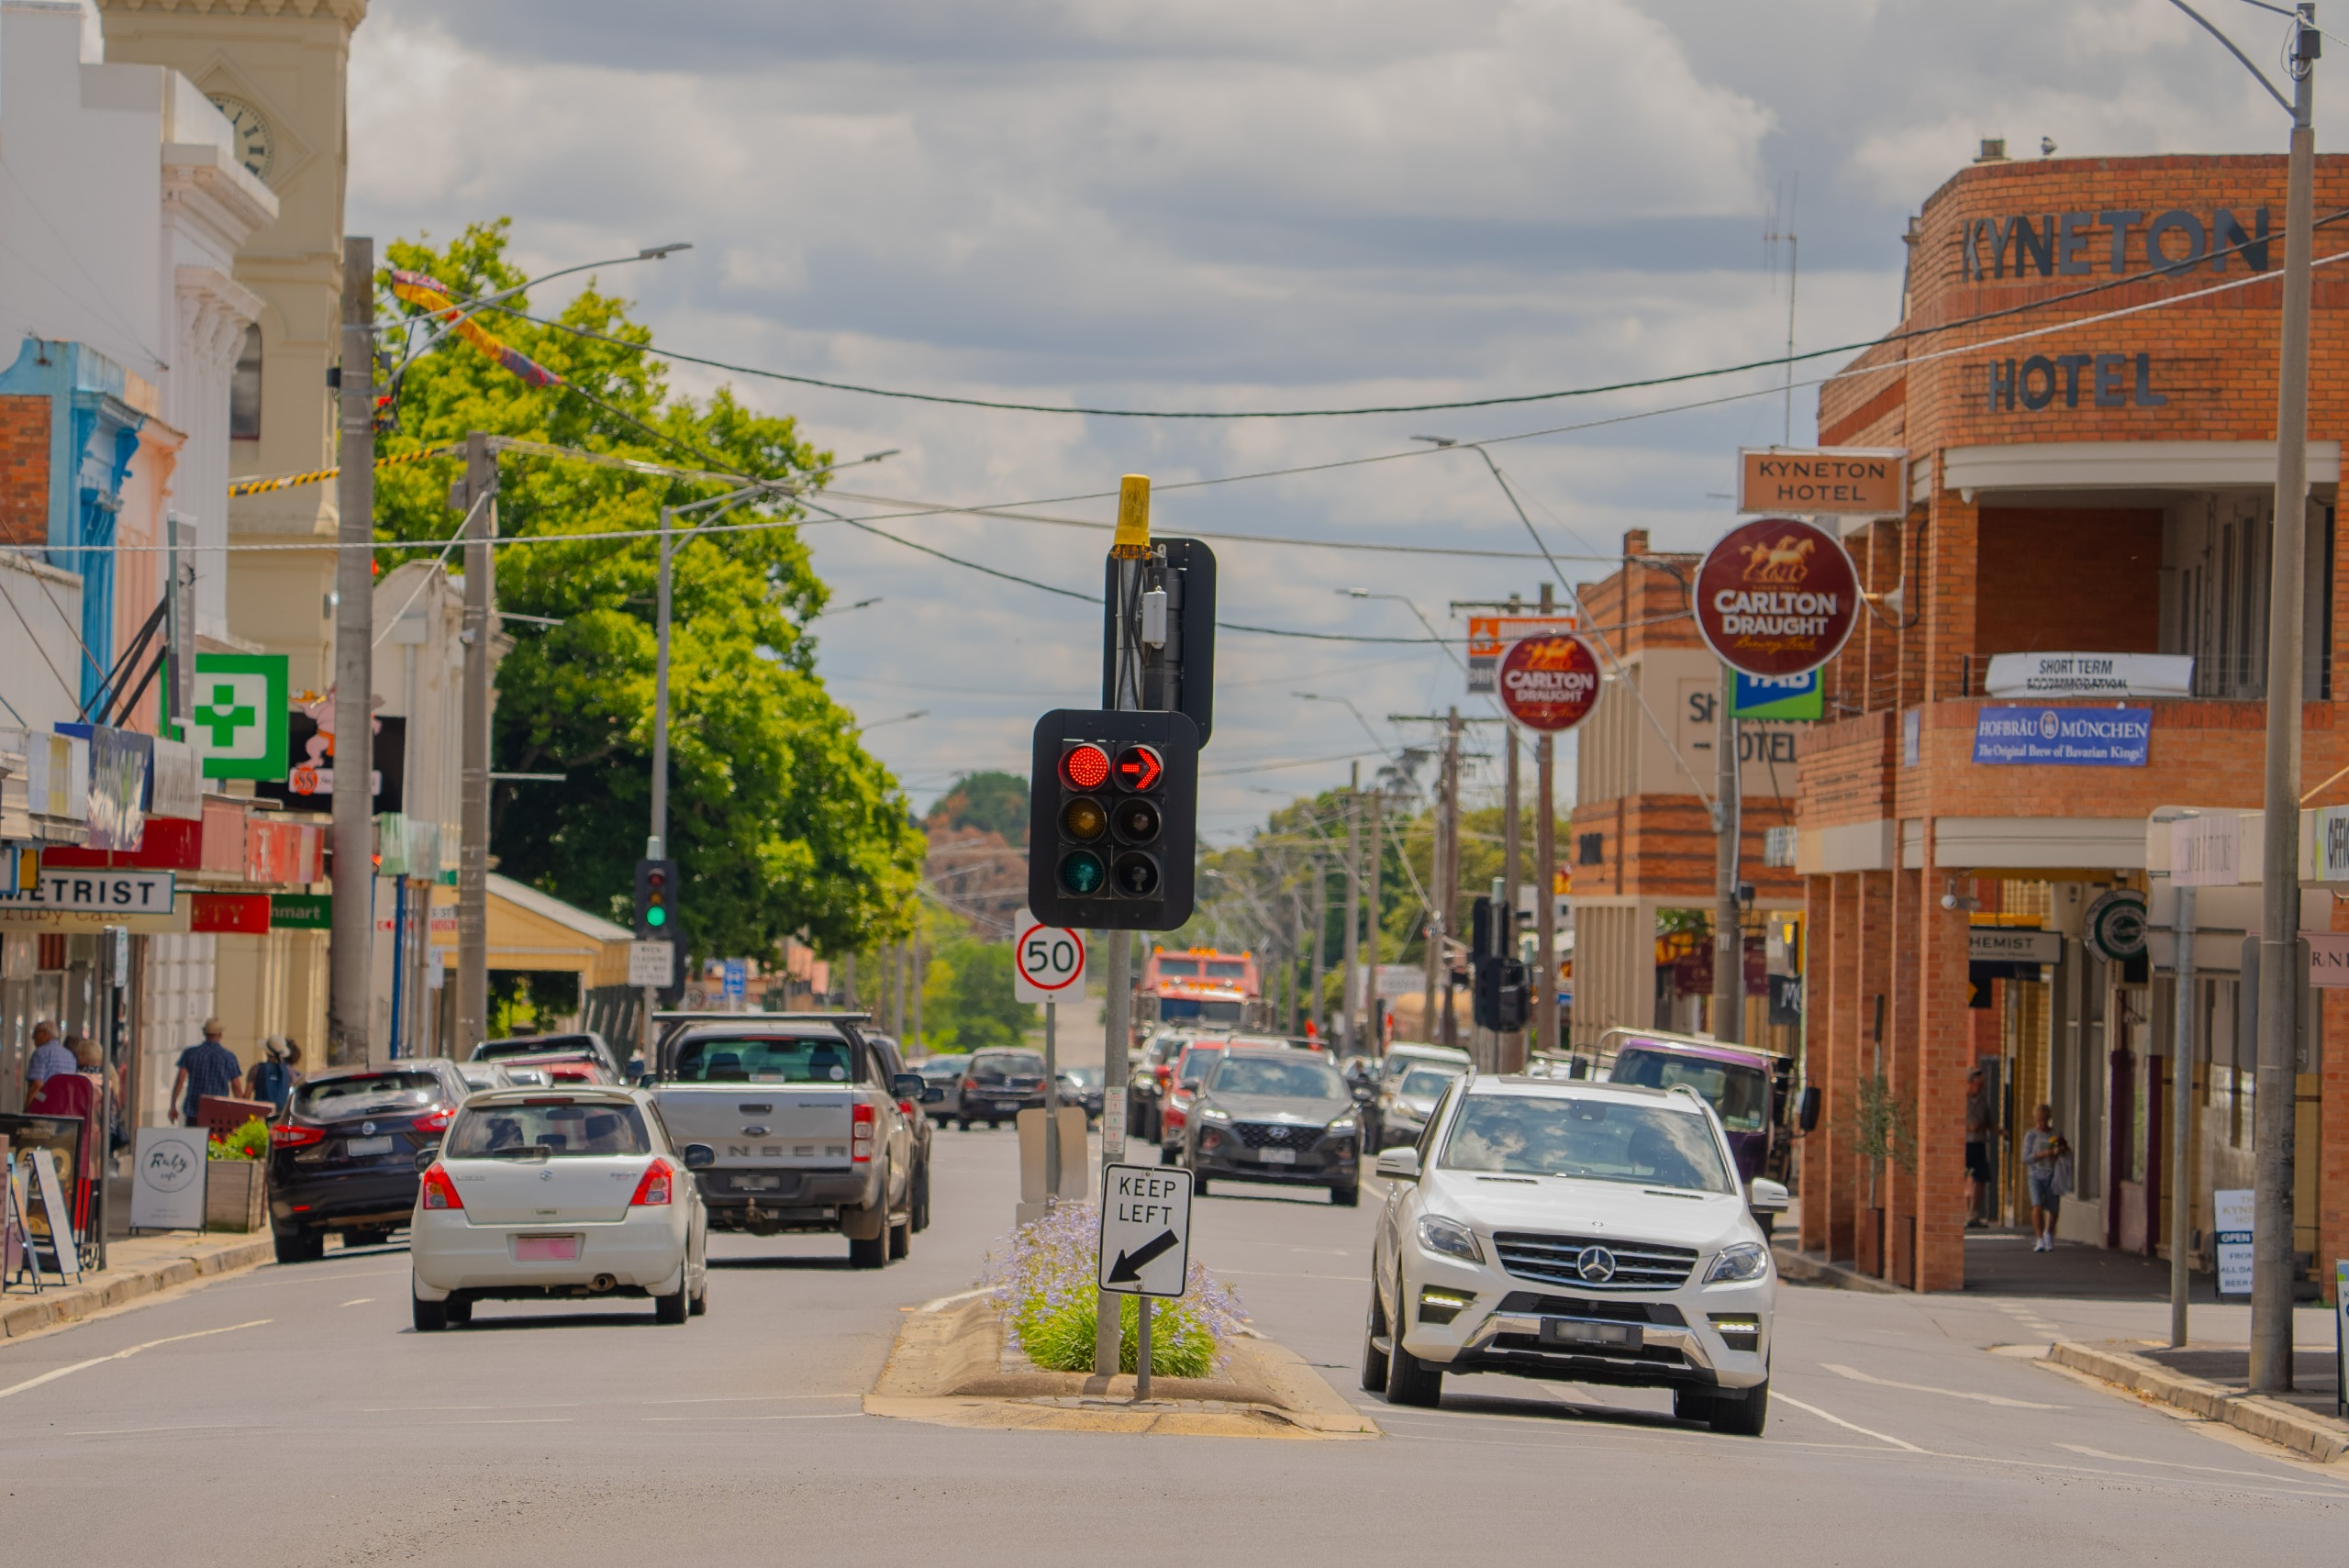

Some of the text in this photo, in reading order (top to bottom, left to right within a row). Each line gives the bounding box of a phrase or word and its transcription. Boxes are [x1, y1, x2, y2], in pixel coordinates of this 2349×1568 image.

[1962, 207, 2269, 284] KYNETON
[1988, 353, 2167, 413] HOTEL
[1759, 461, 1885, 479] KYNETON
[1777, 484, 1867, 502] HOTEL
[1713, 589, 1838, 616] CARLTON
[1722, 614, 1829, 636] DRAUGHT
[2039, 659, 2113, 674] SHORT TERM
[1505, 669, 1595, 690] CARLTON
[1515, 688, 1584, 703] DRAUGHT
[1979, 718, 2038, 737] HOFBRÄU
[2061, 719, 2148, 740] MÜNCHEN
[2029, 744, 2052, 758] Brew
[2054, 744, 2064, 758] of
[2065, 745, 2108, 759] Bavarian
[1028, 940, 1074, 973] 50
[1119, 1176, 1176, 1198] KEEP
[1119, 1203, 1173, 1225] LEFT
[2221, 1233, 2251, 1243] OPEN
